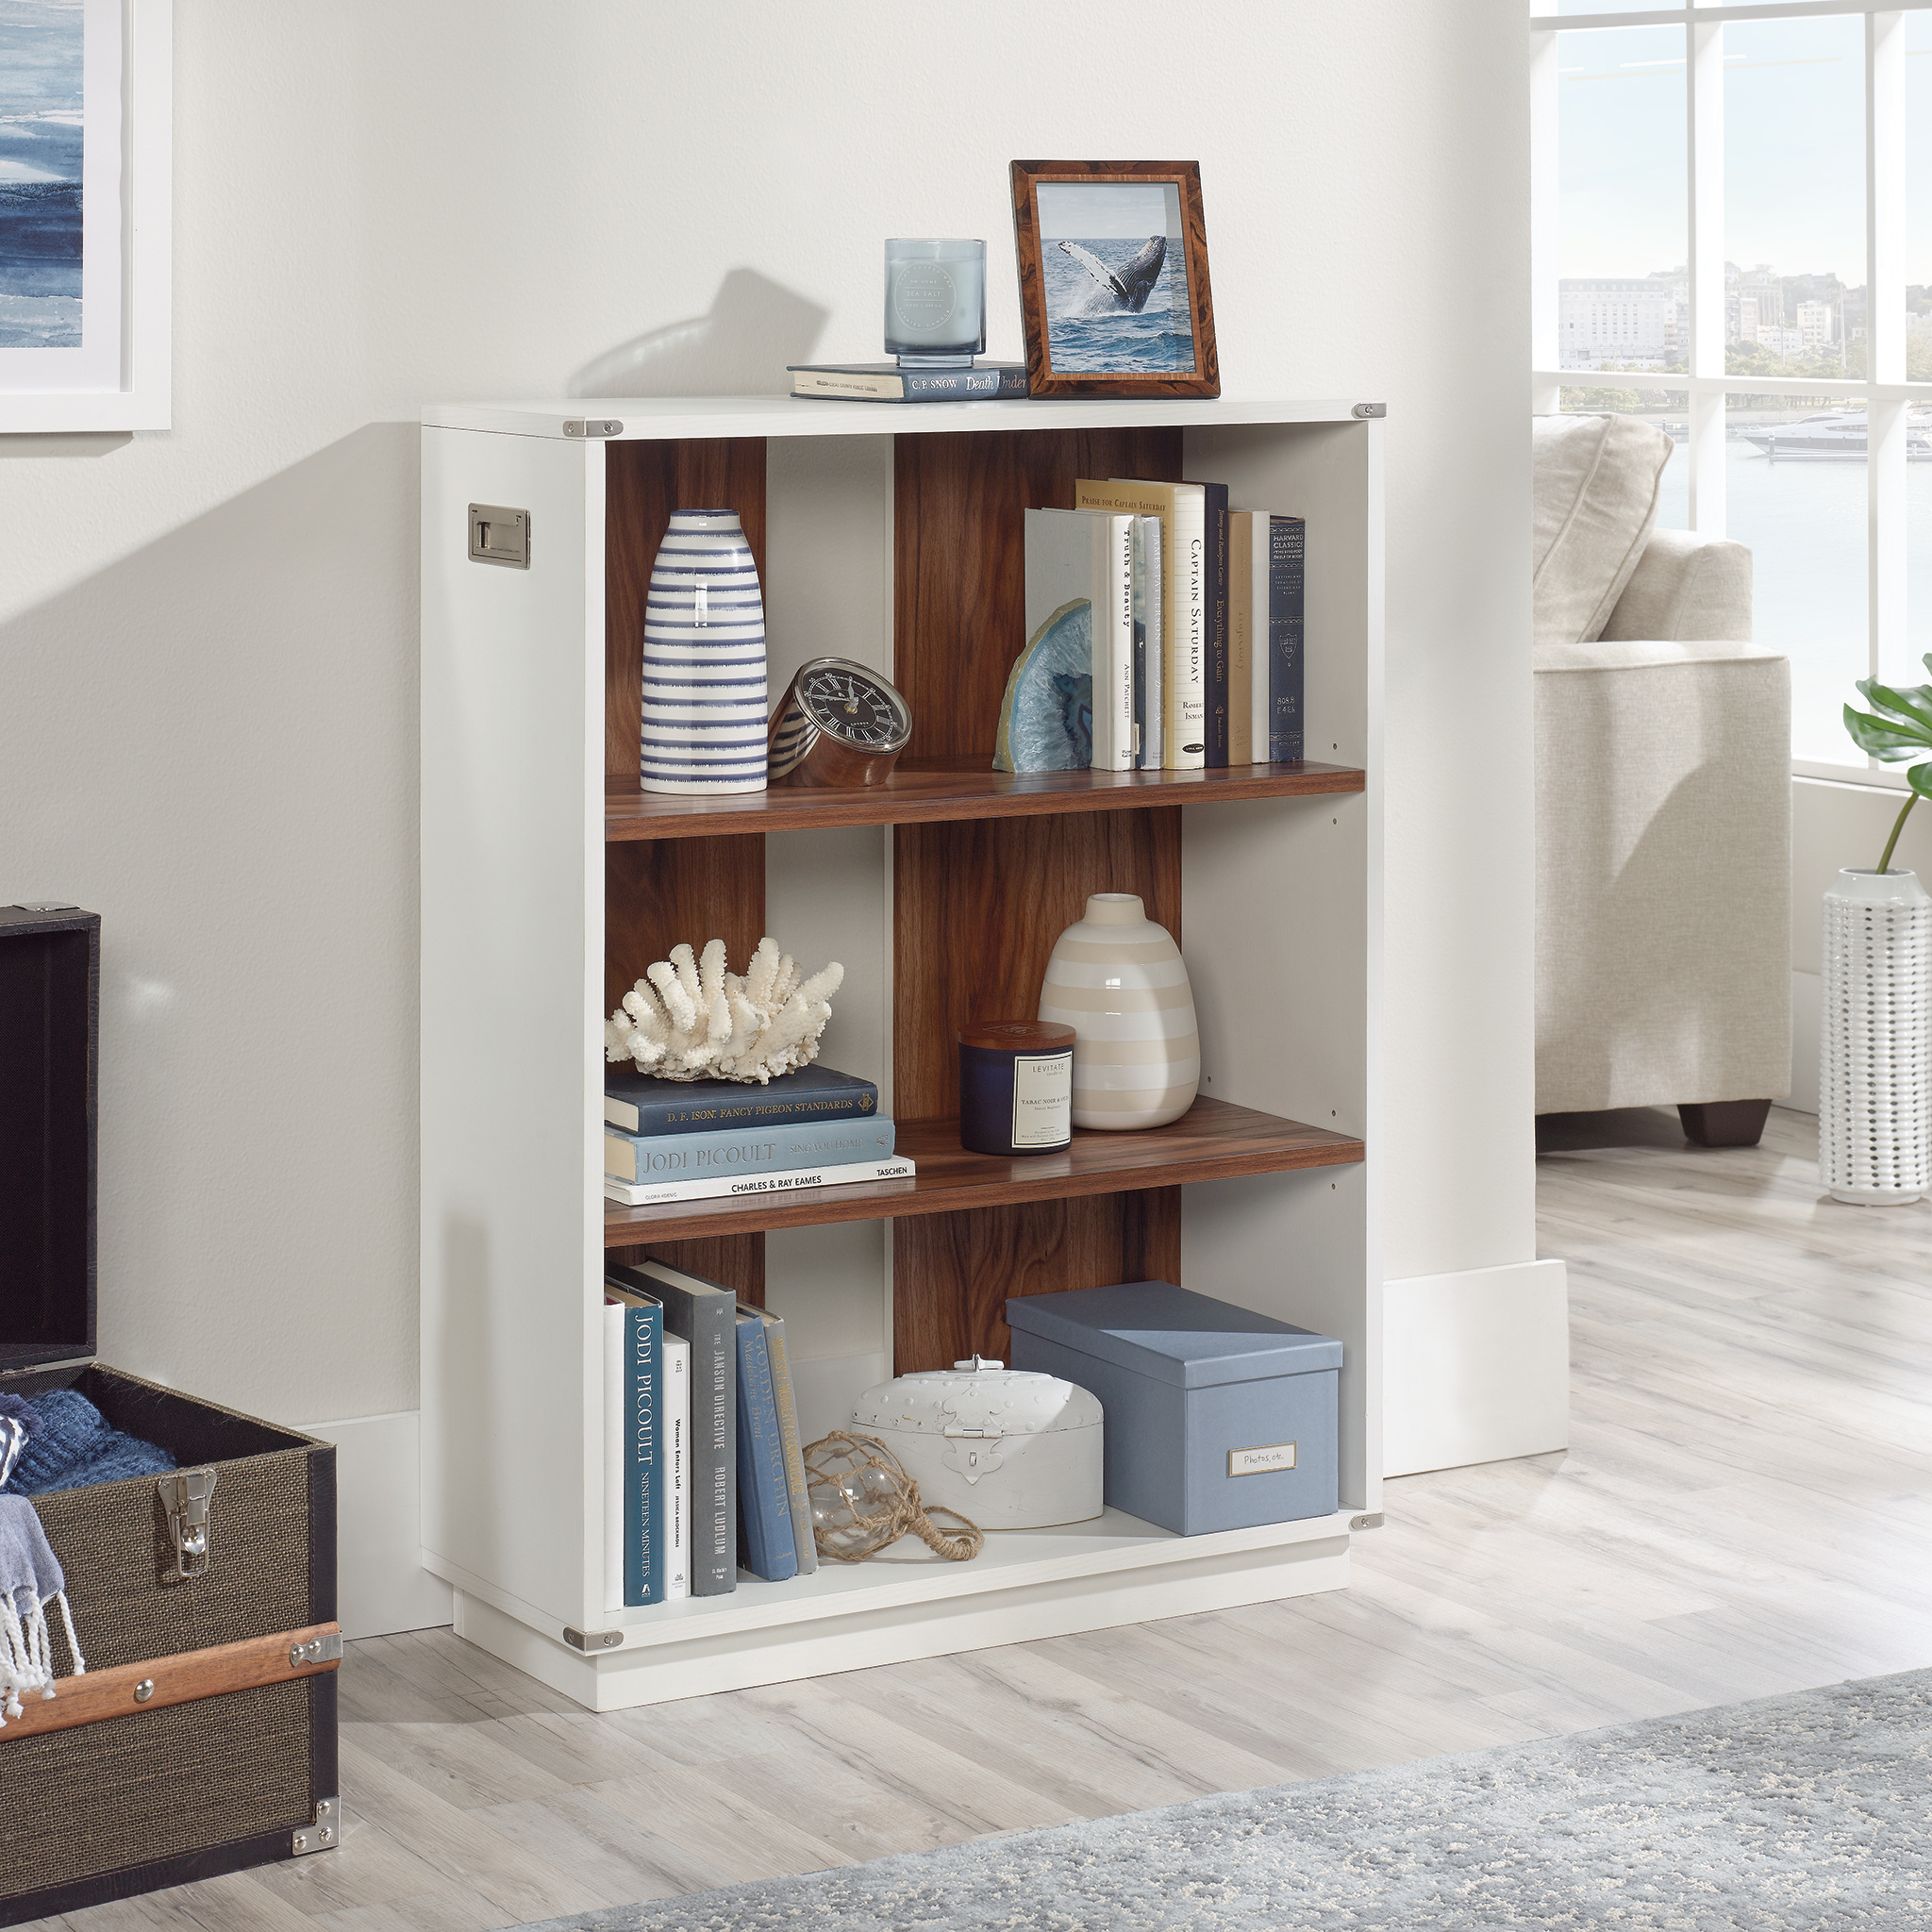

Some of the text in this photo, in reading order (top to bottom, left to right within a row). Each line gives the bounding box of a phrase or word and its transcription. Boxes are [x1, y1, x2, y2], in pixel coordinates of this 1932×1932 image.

[930, 379, 958, 390] SNOW
[966, 376, 994, 391] Death
[997, 375, 1026, 390] Under
[1082, 495, 1166, 511] PRAISE FOR CAPTAIN SATURDAY
[1152, 534, 1161, 570] JAMES
[1123, 584, 1131, 627] Beauty
[1191, 539, 1202, 683] CAPTAIN SATURDAY
[1213, 599, 1224, 682] Everything to Gain
[1032, 1062, 1064, 1073] LEVITATE
[667, 1112, 677, 1123] D.
[680, 1111, 689, 1121] F.
[720, 1107, 753, 1118] FANCY
[755, 1104, 792, 1115] PIGEON
[794, 1100, 853, 1112] STANDARDS
[642, 1142, 776, 1174] JODI PICOULT
[789, 1139, 863, 1155] SING YOU HOME
[731, 1175, 822, 1192] CHARLES & RAY EAMES
[876, 1166, 908, 1176] TASCHEN
[634, 1314, 654, 1365] JODI
[714, 1350, 725, 1391] JANSON
[743, 1340, 763, 1439] Madeleine Brent
[636, 1373, 653, 1466] PICOULT
[714, 1394, 725, 1450] DIRECTIVE
[755, 1333, 789, 1517] GOLDEN URCHIN
[784, 1429, 796, 1439] &
[785, 1438, 805, 1496] CONSCIENCE
[1243, 1454, 1272, 1466] Photos,
[641, 1472, 651, 1526] NINETEEN
[714, 1466, 726, 1507] ROBERT
[641, 1529, 651, 1577] MINUTES
[714, 1511, 726, 1556] LUDLUM
